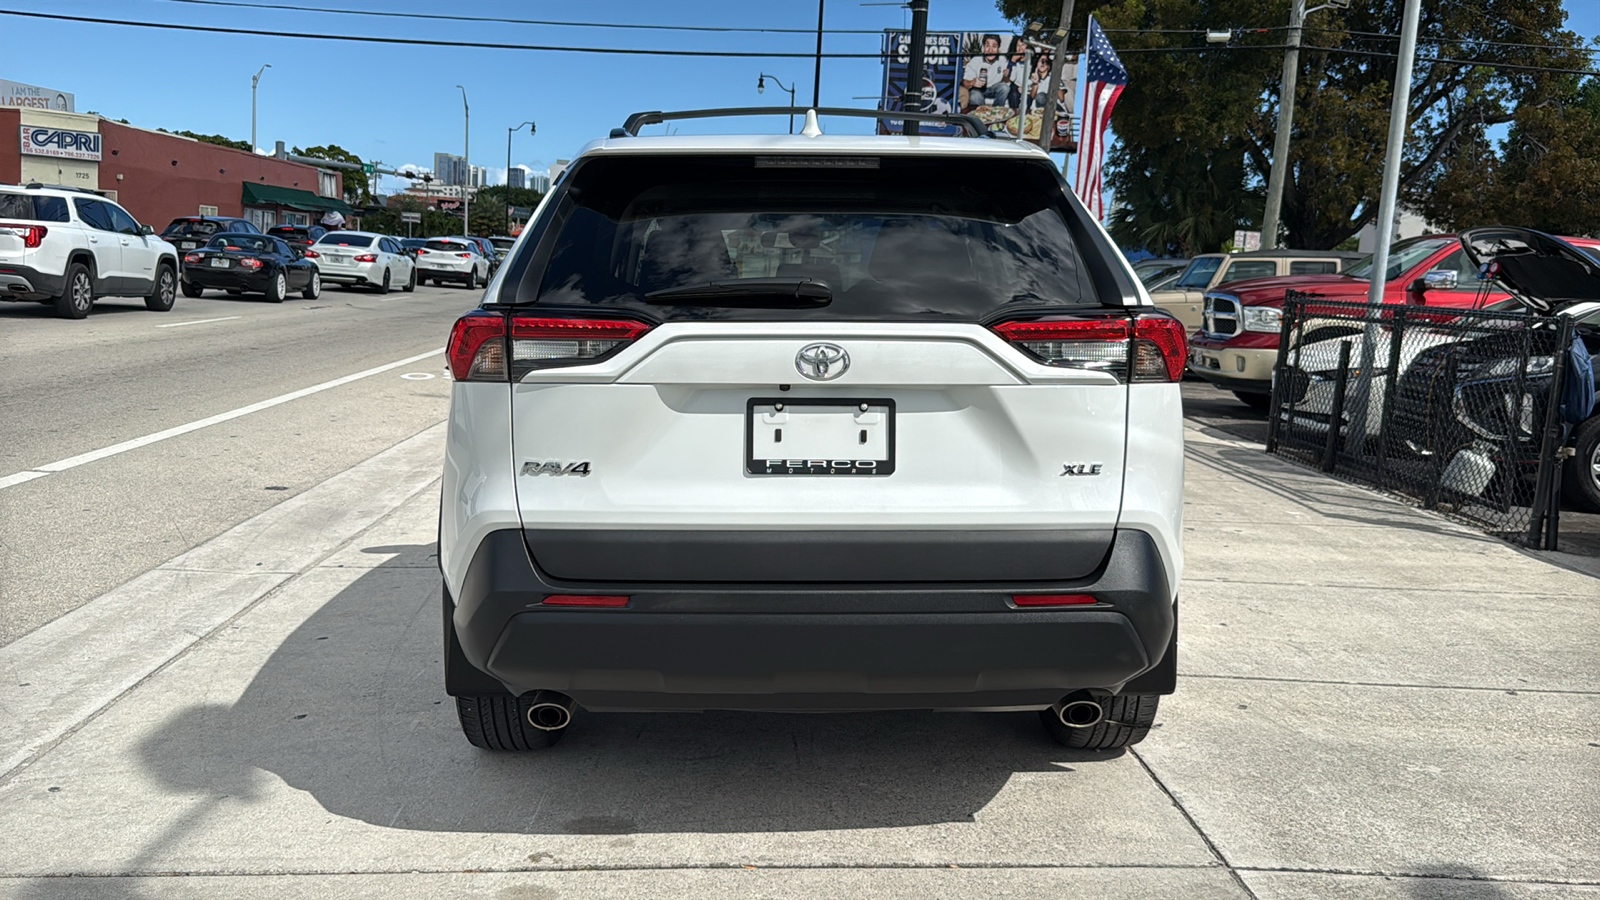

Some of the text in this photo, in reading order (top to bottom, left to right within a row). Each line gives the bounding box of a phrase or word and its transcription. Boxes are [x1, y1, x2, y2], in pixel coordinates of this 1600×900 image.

[938, 36, 951, 46] DEL
[15, 87, 27, 96] AM
[27, 87, 41, 96] THE
[1, 96, 50, 109] LARGEST
[22, 127, 31, 148] BAR
[31, 129, 99, 153] CAPRI
[75, 172, 90, 180] 1725
[519, 461, 592, 477] RAV4
[765, 459, 877, 468] FERCO
[1059, 463, 1103, 477] XLE
